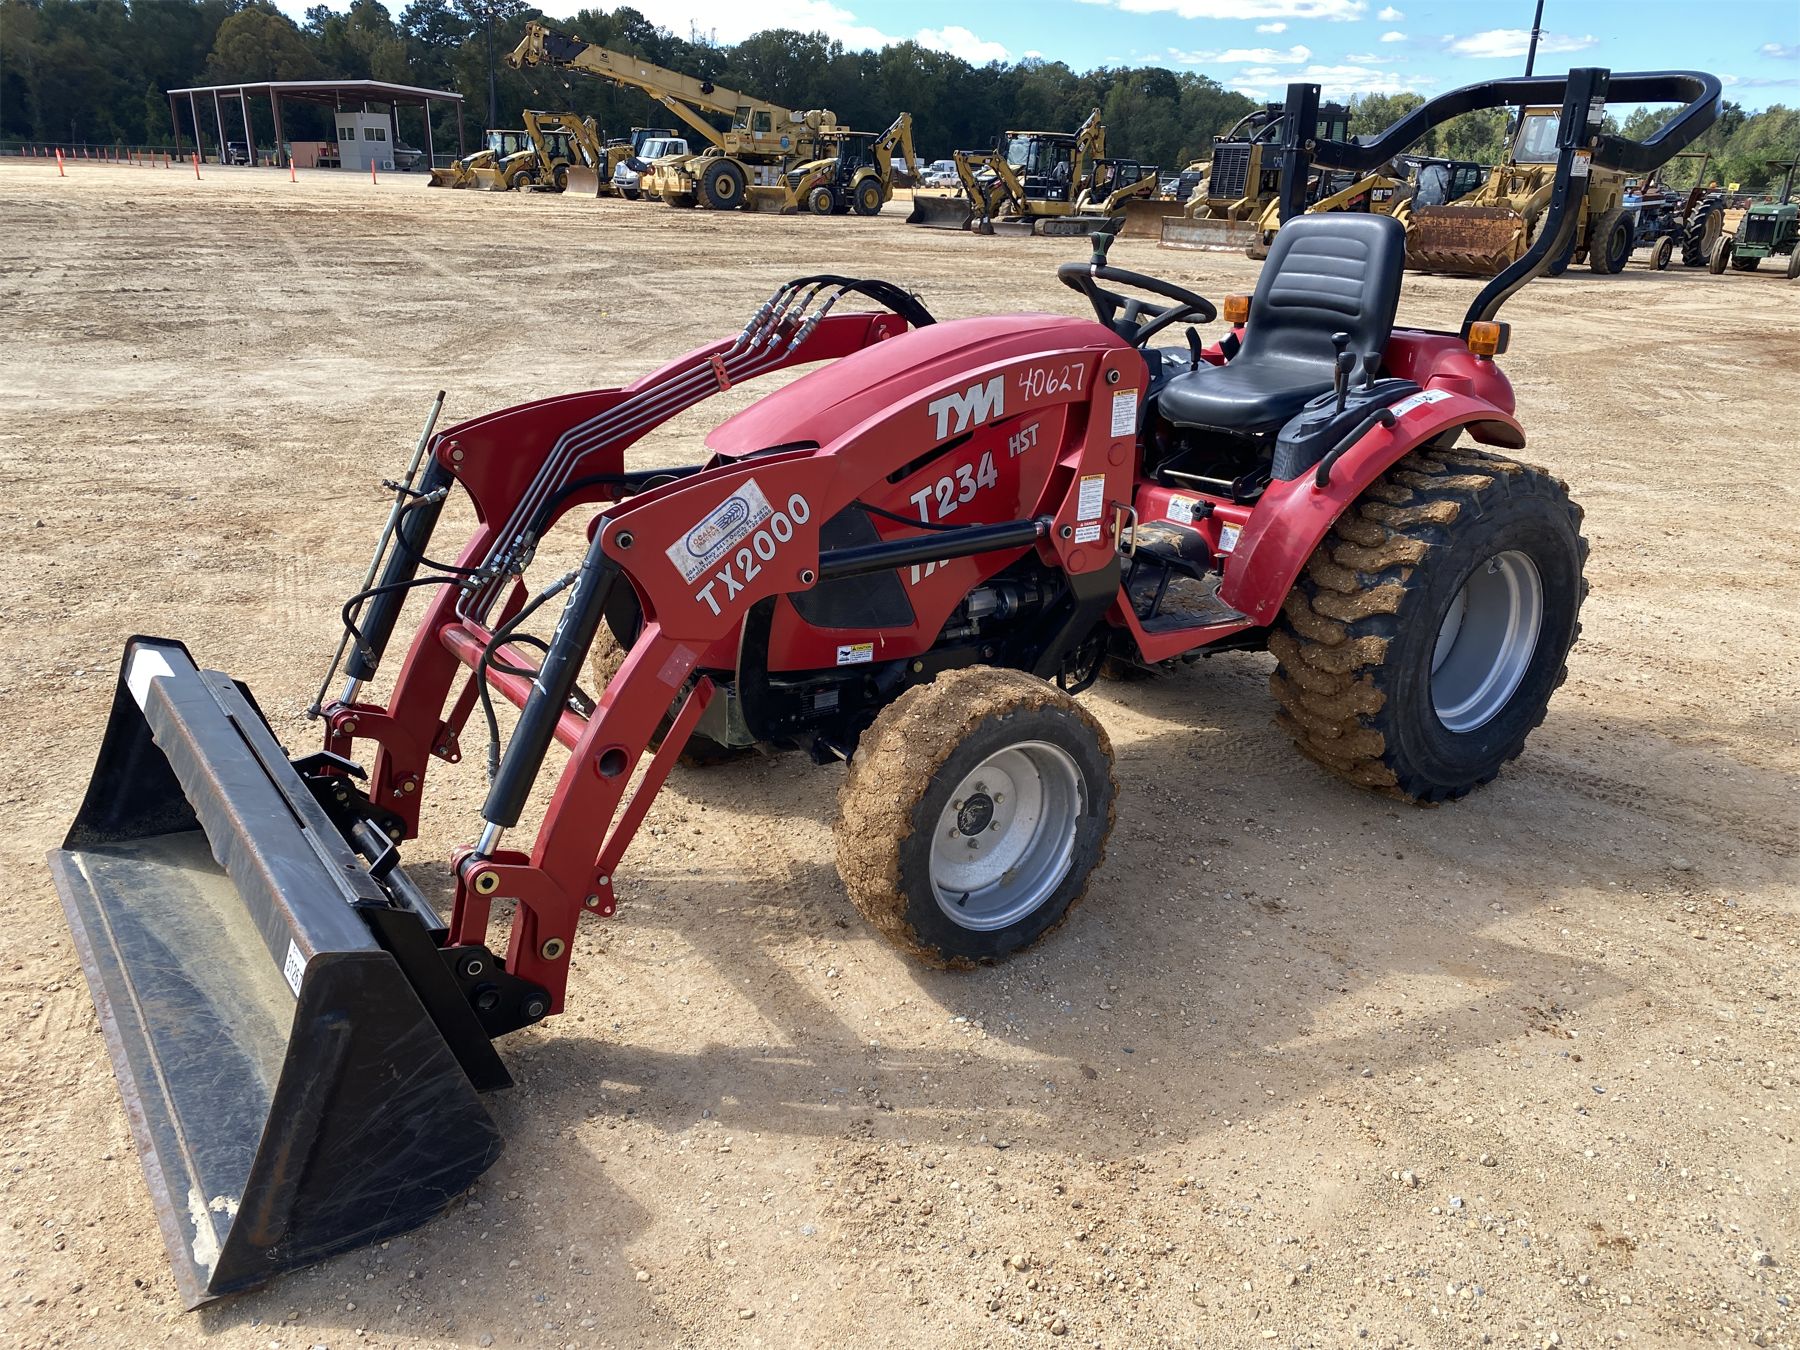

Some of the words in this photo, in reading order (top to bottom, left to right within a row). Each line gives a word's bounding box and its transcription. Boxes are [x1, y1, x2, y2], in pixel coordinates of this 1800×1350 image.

[1372, 189, 1384, 201] CAT
[1018, 363, 1085, 401] 40627
[928, 374, 1005, 441] TYM
[1008, 423, 1039, 458] HST
[910, 450, 998, 524] T234
[693, 525, 715, 546] OCALA
[695, 493, 810, 616] TX2000
